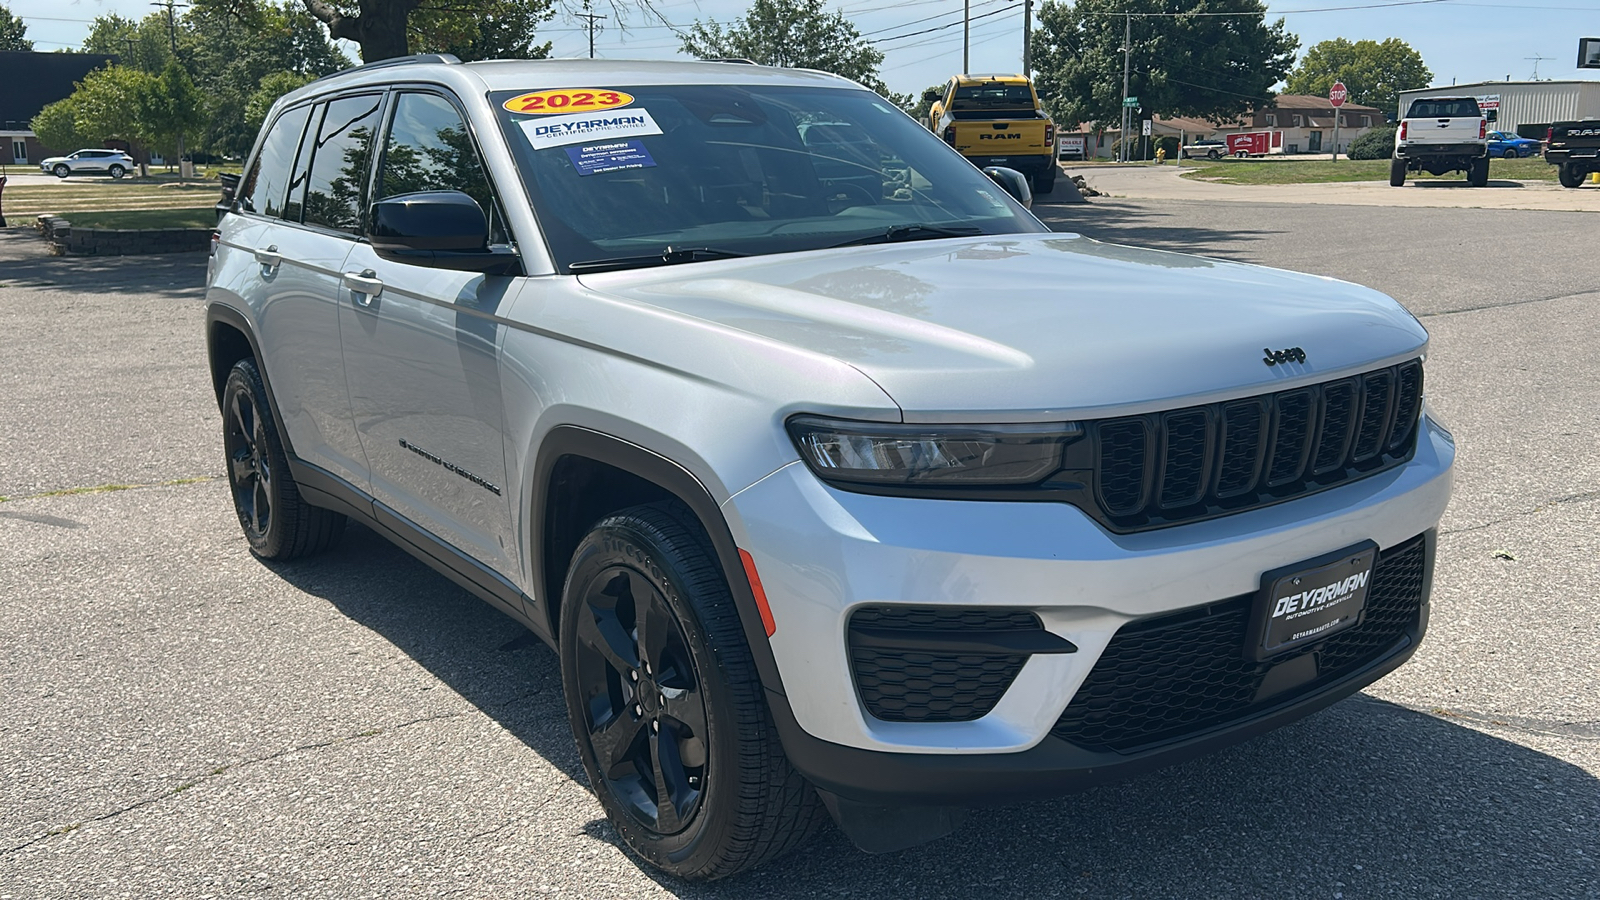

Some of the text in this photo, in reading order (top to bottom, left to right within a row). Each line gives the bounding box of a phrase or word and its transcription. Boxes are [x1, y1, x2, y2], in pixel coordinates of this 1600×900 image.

[521, 92, 622, 111] 2023
[1330, 90, 1346, 100] STOP
[535, 116, 645, 136] DEYARMAN
[546, 123, 646, 139] CERTIFIED PRE-OWNED
[582, 142, 629, 152] DEYARMAN
[1263, 347, 1306, 366] Jeep
[1272, 569, 1370, 618] DEYARMAN
[1292, 618, 1340, 640] DEYARMANAUTO.COM
